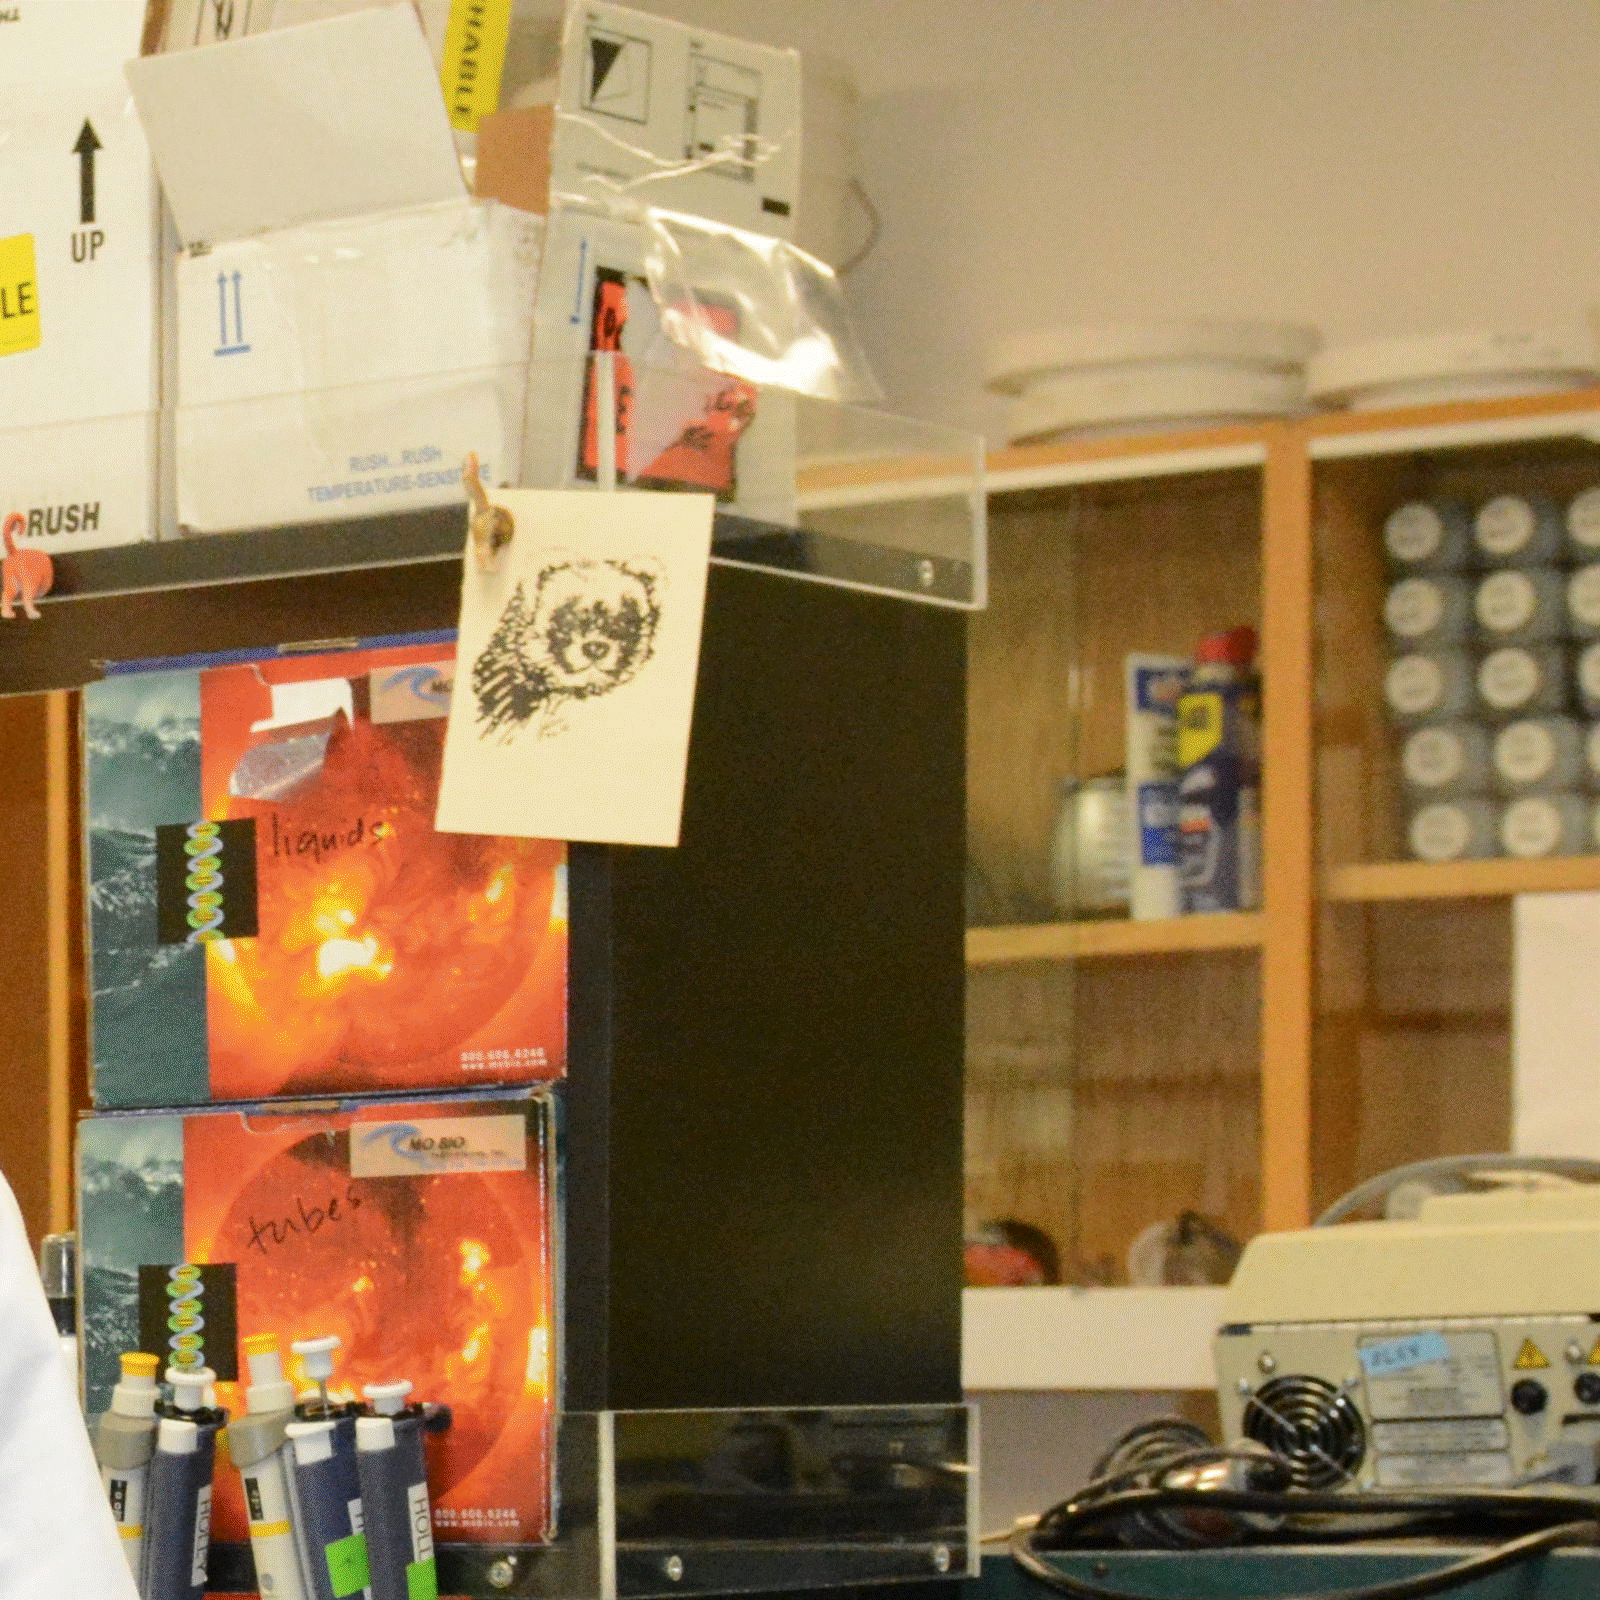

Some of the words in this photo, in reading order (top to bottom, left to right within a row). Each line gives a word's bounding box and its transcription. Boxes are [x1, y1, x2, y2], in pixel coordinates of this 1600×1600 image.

[72, 229, 105, 264] UP
[26, 501, 102, 539] RUSH
[271, 812, 388, 864] liquids
[246, 1183, 363, 1256] tubes
